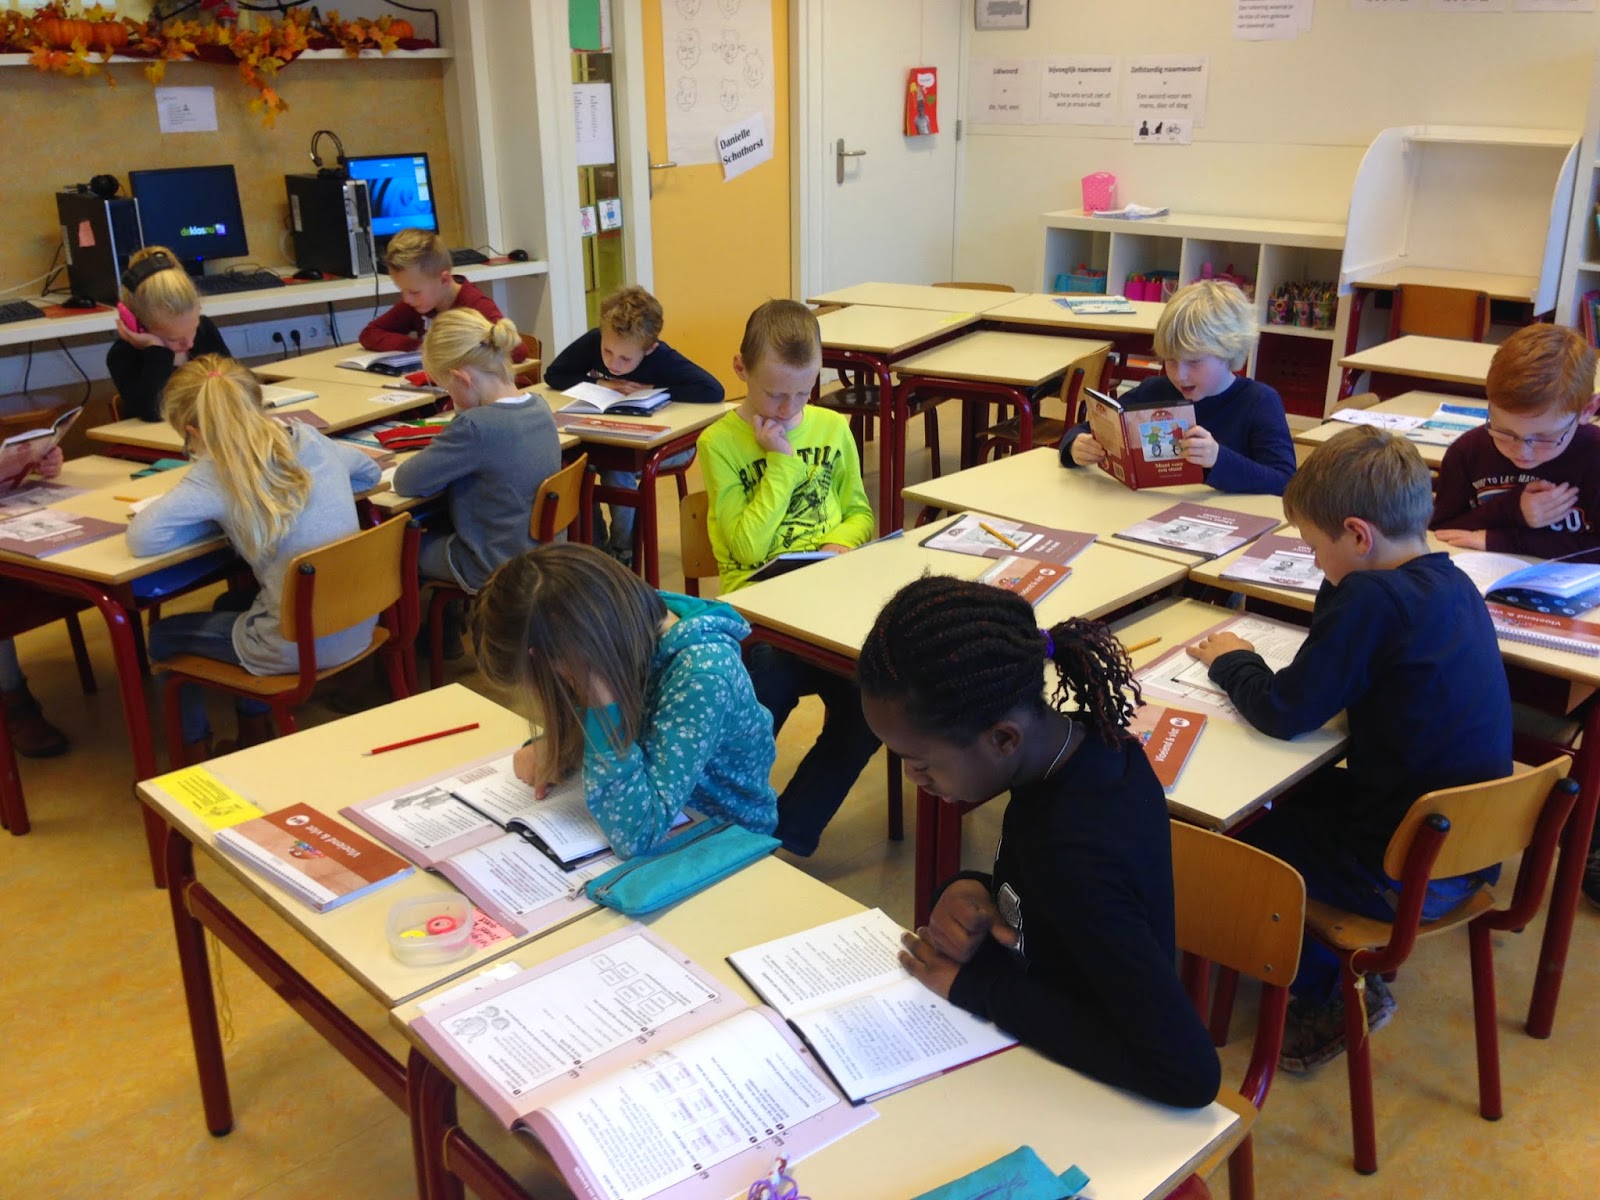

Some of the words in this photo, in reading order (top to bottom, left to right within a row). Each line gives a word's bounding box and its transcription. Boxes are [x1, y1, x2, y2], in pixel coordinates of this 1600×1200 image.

[720, 129, 751, 150] Danielle
[722, 138, 764, 165] Schothorst
[1517, 613, 1561, 627] Vloeiend
[1155, 740, 1173, 762] Vloeiend
[324, 837, 361, 858] Vloeiend
